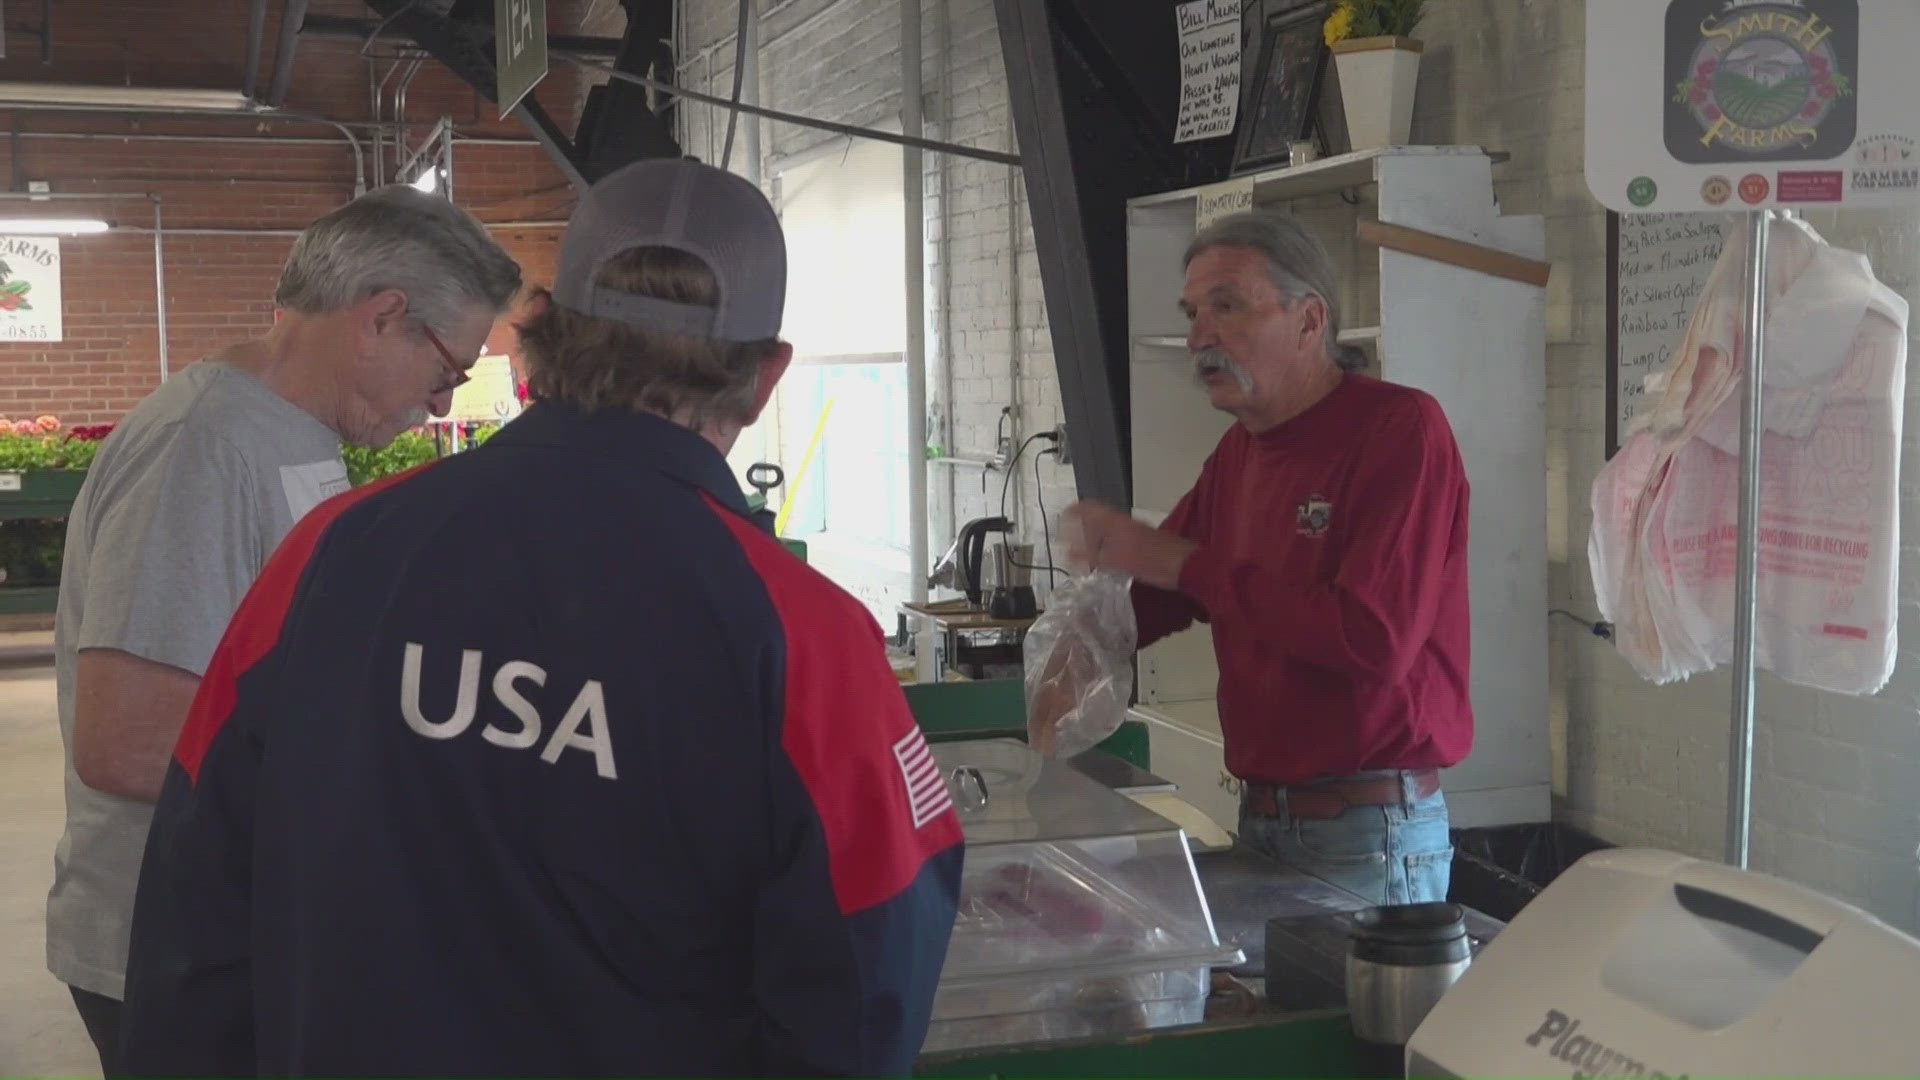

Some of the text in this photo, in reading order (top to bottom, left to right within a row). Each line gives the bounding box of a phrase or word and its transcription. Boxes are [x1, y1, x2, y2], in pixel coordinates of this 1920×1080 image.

[1180, 6, 1204, 30] BILL
[1700, 12, 1833, 51] SMITH
[1182, 33, 1236, 58] OUR LONGTIME
[1185, 61, 1209, 79] HONEY
[1700, 113, 1817, 149] FARMS
[1621, 345, 1654, 374] Lump
[1823, 536, 1869, 560] RECYCLING
[400, 641, 618, 780] USA
